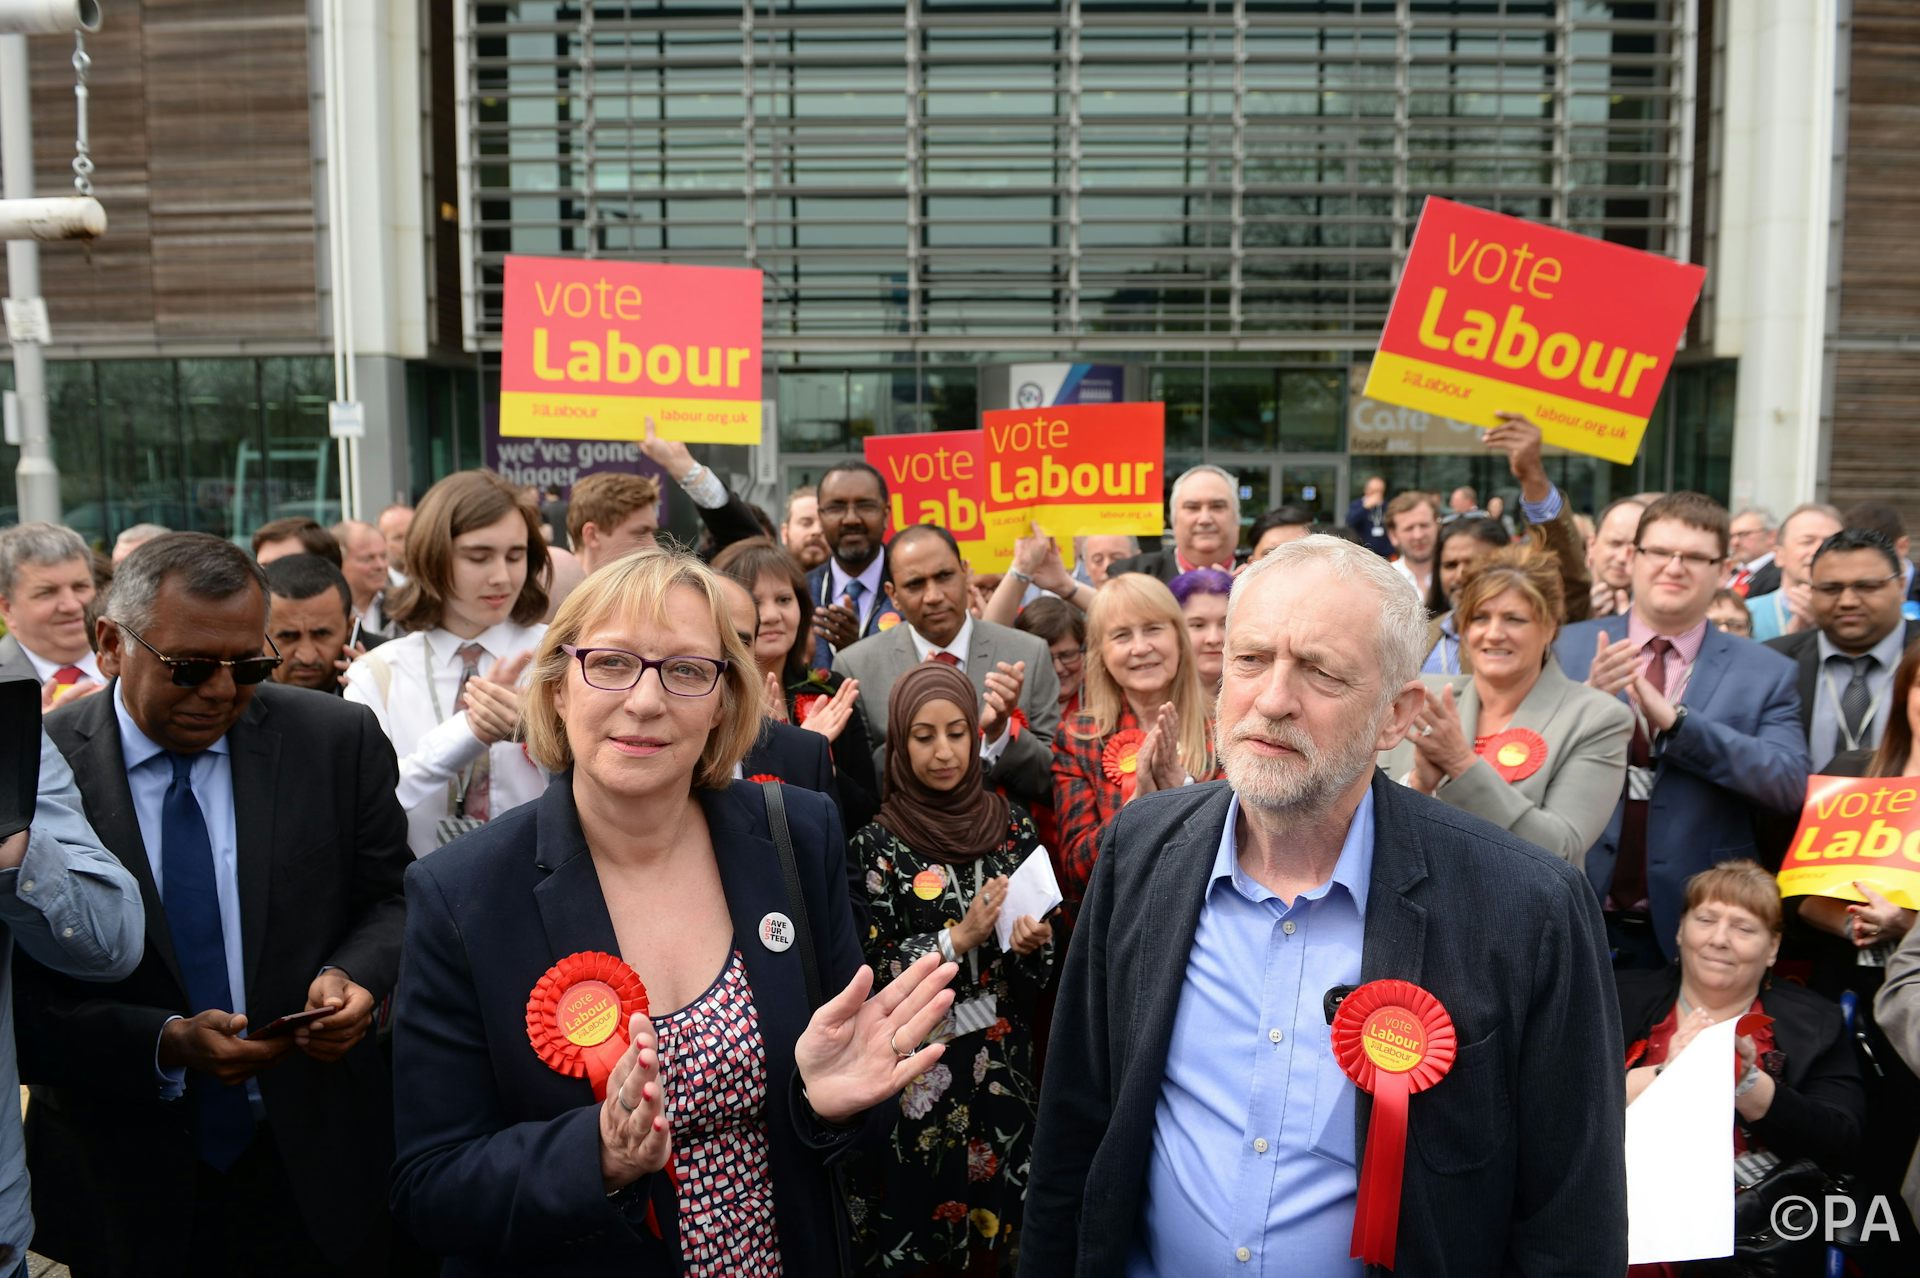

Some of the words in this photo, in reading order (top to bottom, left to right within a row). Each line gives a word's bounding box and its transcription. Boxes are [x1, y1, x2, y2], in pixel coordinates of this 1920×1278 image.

[1447, 232, 1562, 299] vote
[534, 277, 642, 320] vote
[532, 327, 751, 388] Labour
[1418, 286, 1658, 398] Labour
[660, 408, 749, 426] labour.org.uk
[1536, 404, 1629, 438] labour.org.uk
[989, 416, 1070, 454] vote
[496, 438, 571, 463] we've
[577, 442, 641, 468] gone
[888, 446, 974, 483] vote
[498, 461, 580, 491] bigger
[989, 454, 1154, 503] Labour
[891, 487, 985, 532] Lab
[1816, 787, 1918, 820] vote
[764, 932, 789, 944] STEEL
[765, 926, 782, 935] OUR
[766, 918, 787, 929] SAVE
[565, 998, 608, 1031] Labour
[567, 993, 593, 1013] vote
[1370, 1023, 1420, 1050] Labour
[1385, 1015, 1413, 1034] vote
[1379, 1042, 1412, 1061] Labour
